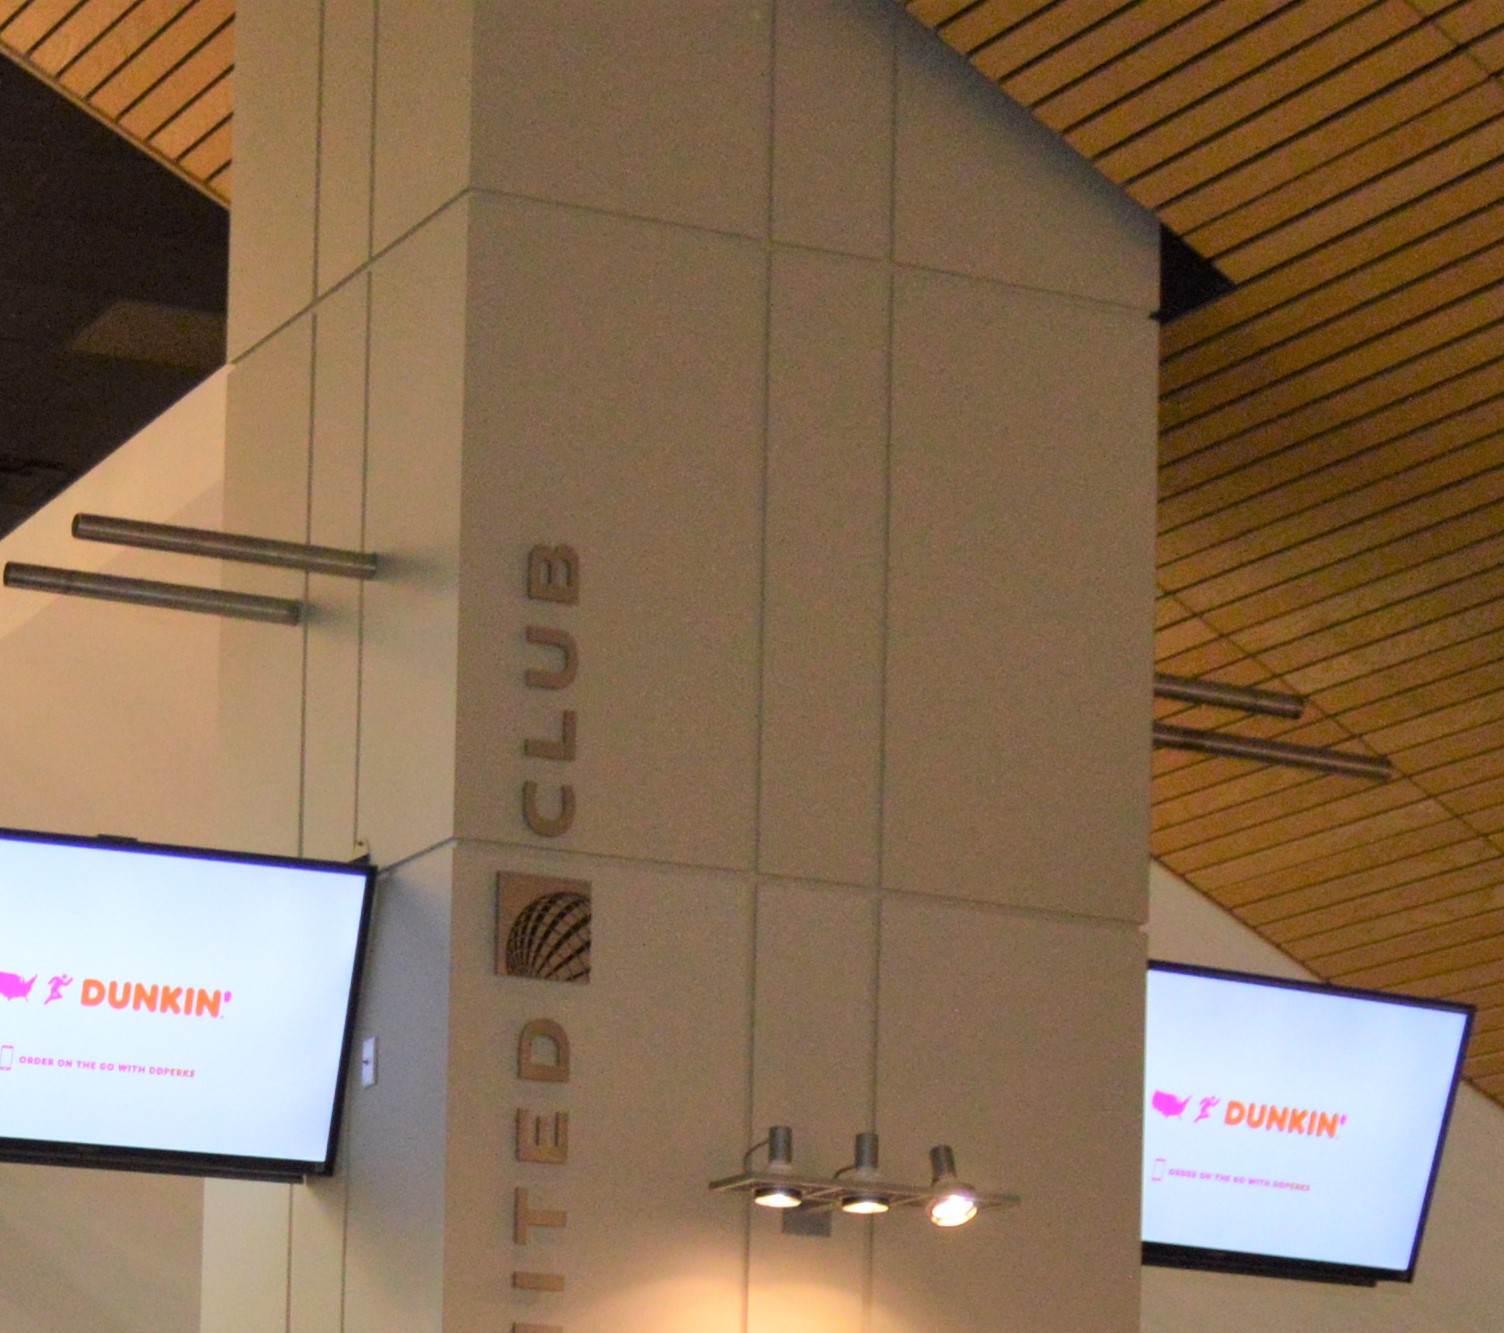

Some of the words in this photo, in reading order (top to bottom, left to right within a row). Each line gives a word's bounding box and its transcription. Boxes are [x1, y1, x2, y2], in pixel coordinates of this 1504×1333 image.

[522, 543, 580, 838] CLUB
[80, 978, 232, 1018] DUNKIN'
[19, 1055, 54, 1067] ORDER
[57, 1058, 73, 1068] ON
[76, 1060, 96, 1070] THE
[99, 1062, 115, 1072] GO
[118, 1063, 146, 1074] WITH
[1224, 1099, 1347, 1138] DUNKIN'
